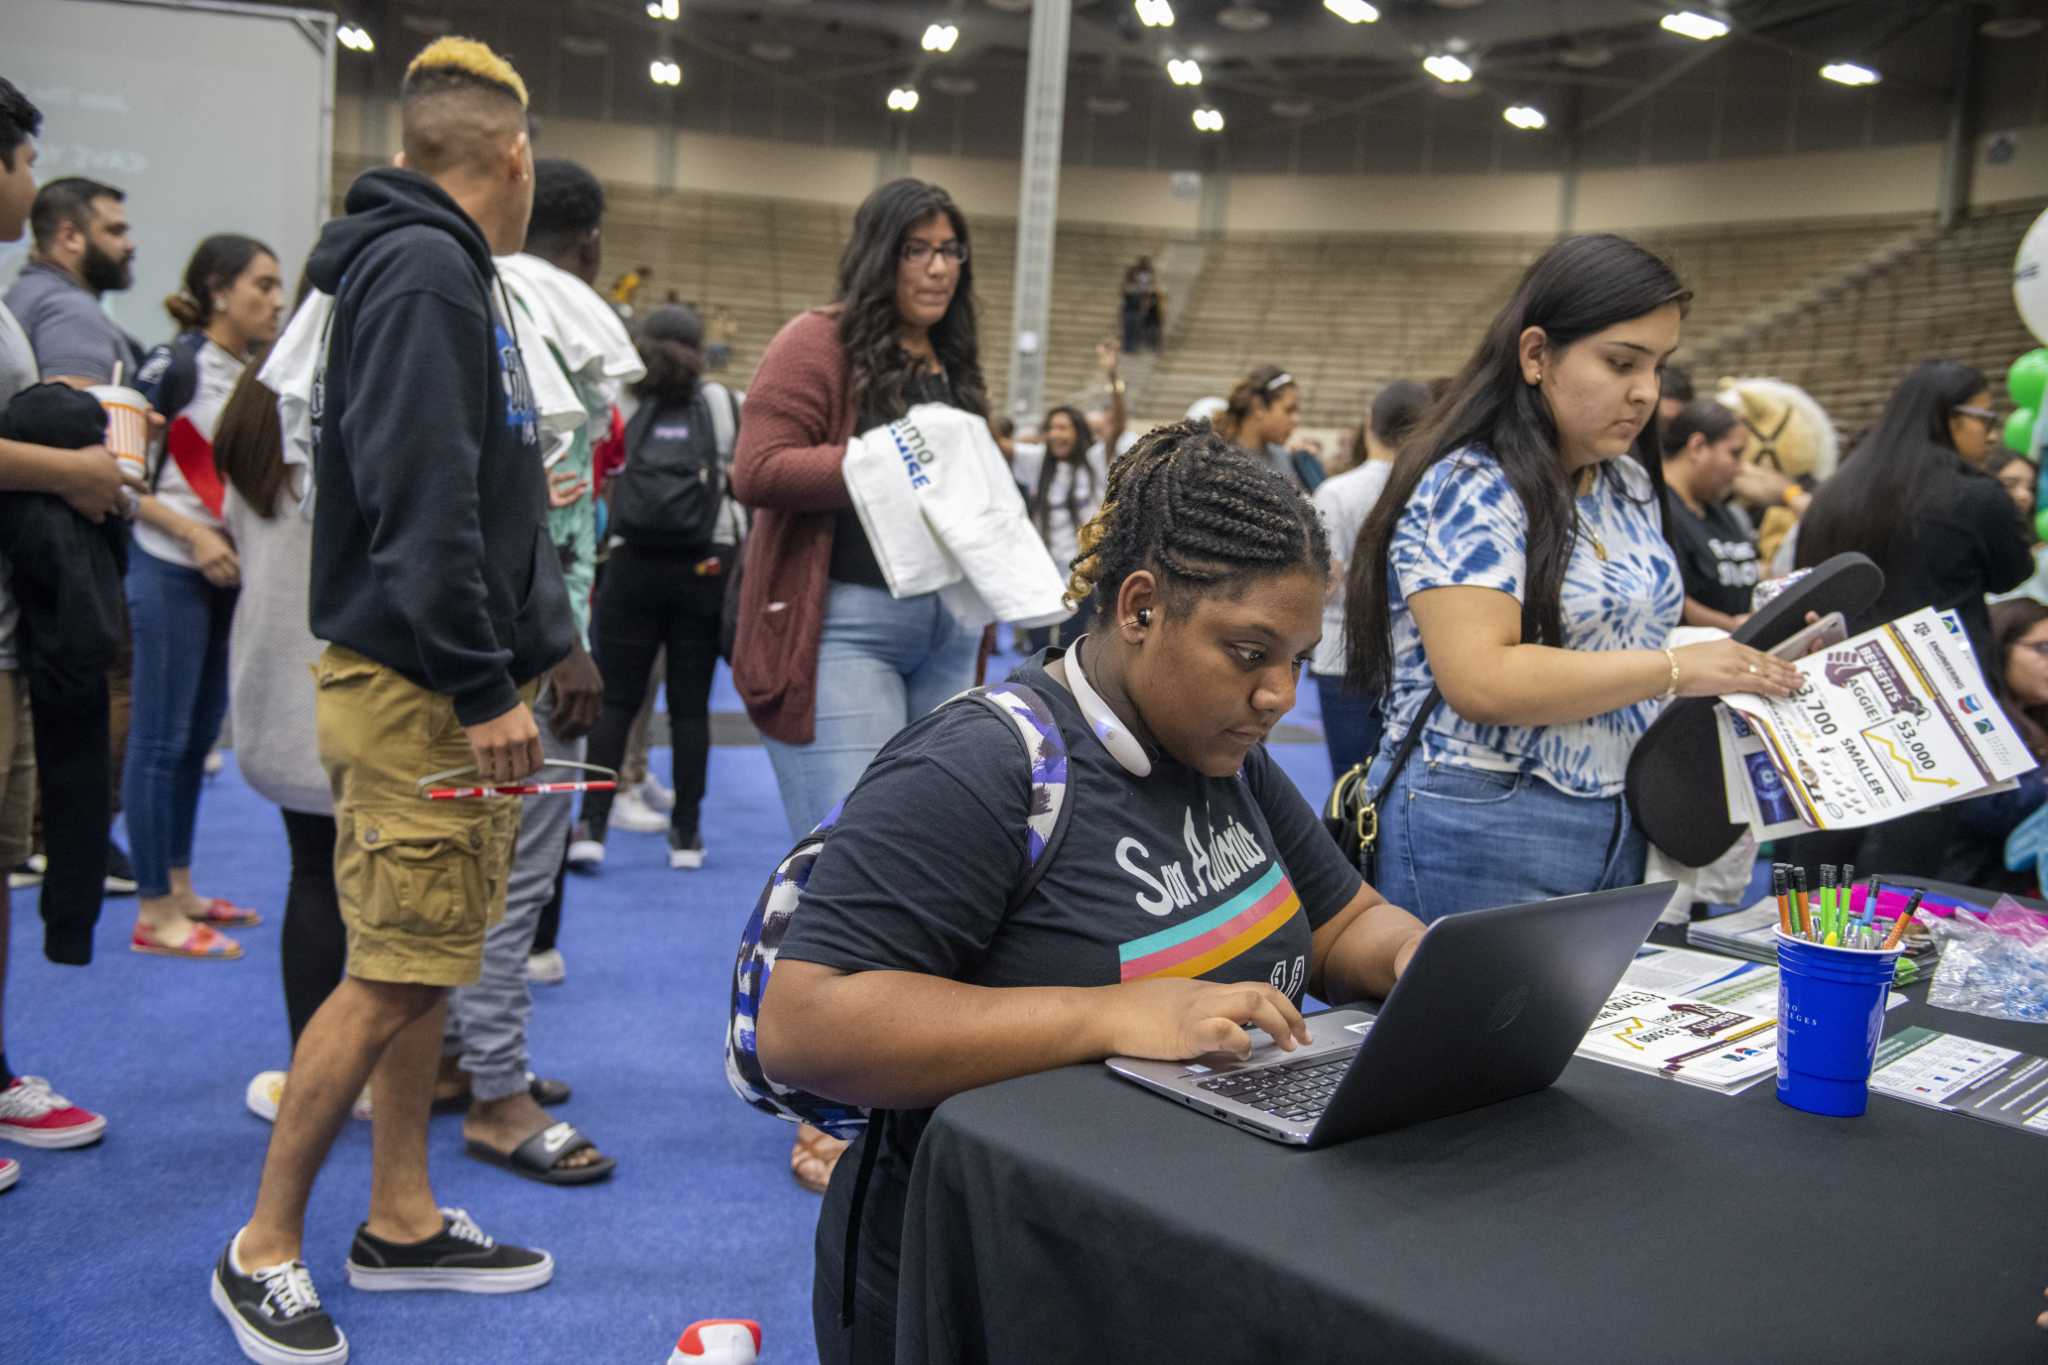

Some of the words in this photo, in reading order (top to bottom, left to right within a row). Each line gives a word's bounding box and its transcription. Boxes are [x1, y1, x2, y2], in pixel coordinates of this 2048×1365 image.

[1847, 677, 1882, 722] AGGIE!
[1857, 644, 1903, 703] BENEFITS
[1795, 683, 1838, 736] 3,700
[1839, 736, 1885, 796] SMALLER
[1115, 837, 1198, 916] San
